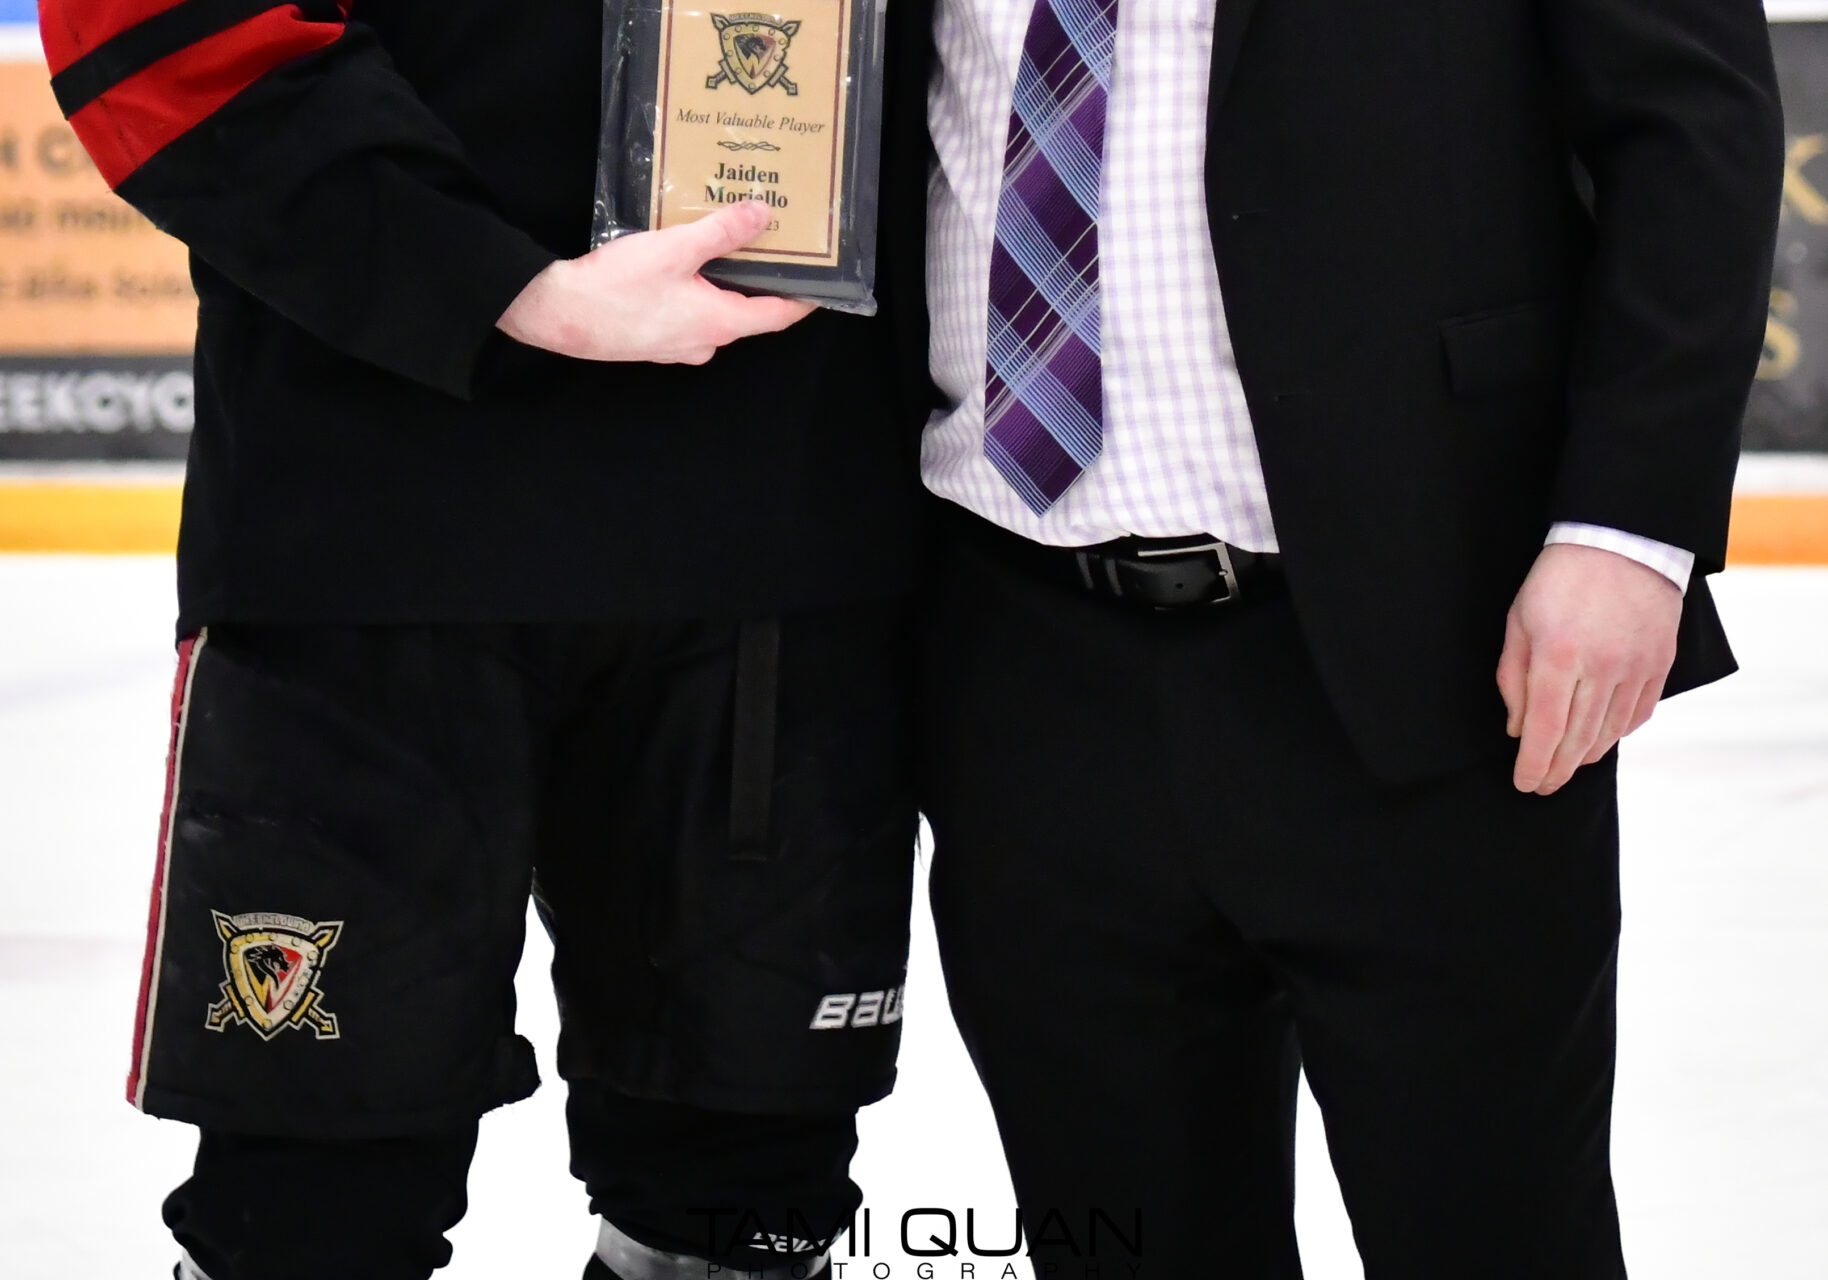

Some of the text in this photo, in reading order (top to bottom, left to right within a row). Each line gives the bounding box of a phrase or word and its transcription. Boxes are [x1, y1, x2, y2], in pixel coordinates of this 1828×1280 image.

[676, 108, 826, 135] Most Valuable Player
[714, 162, 779, 184] Jaiden
[809, 985, 905, 1030] BAU
